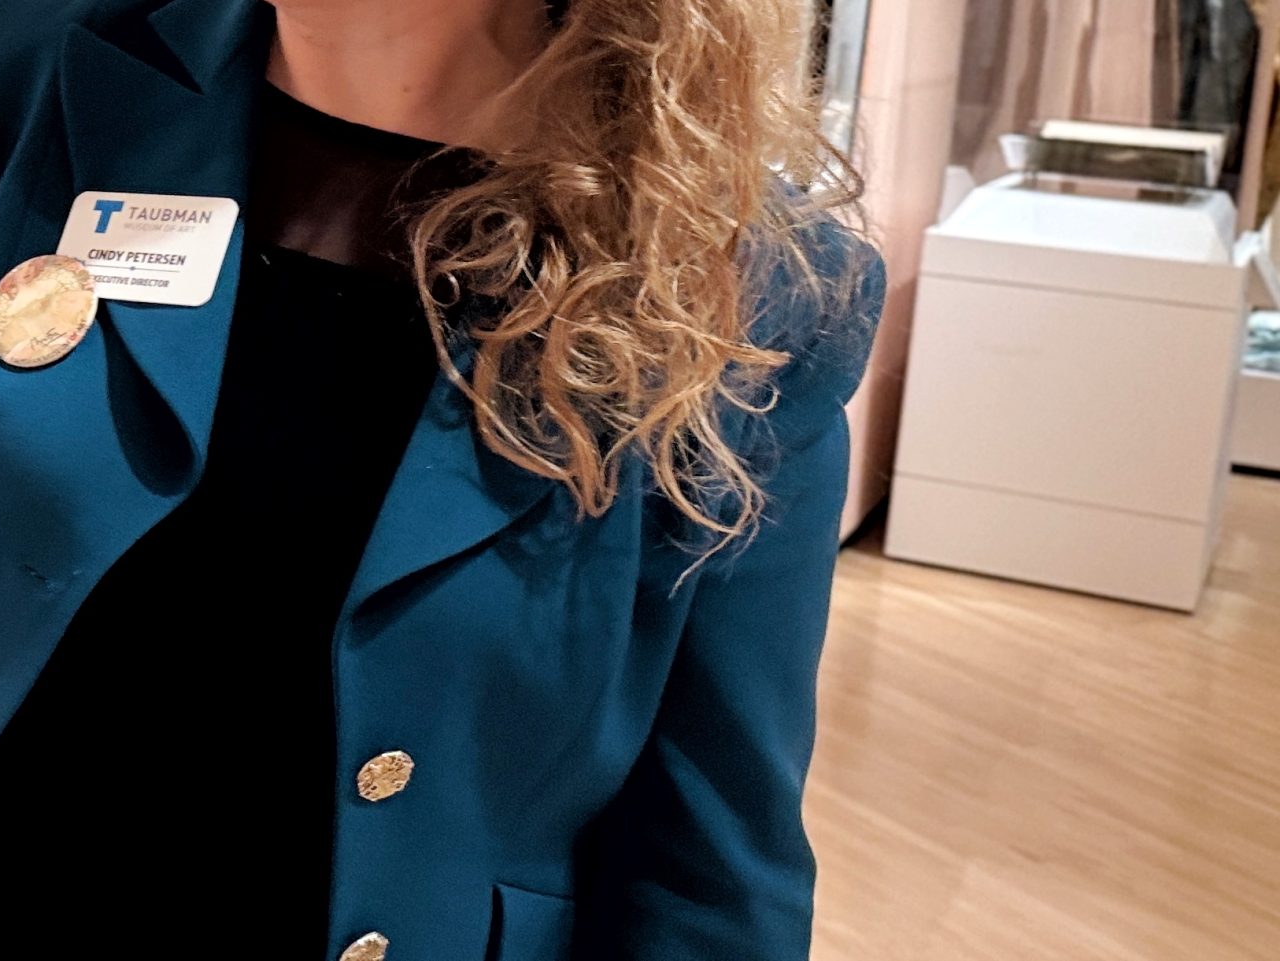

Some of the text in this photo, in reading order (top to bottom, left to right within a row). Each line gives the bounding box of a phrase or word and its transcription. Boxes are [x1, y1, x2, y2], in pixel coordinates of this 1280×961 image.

[93, 199, 213, 234] T TAUBMAN
[88, 248, 187, 266] CINDY PETERSEN
[130, 277, 170, 288] DIRECTOR
